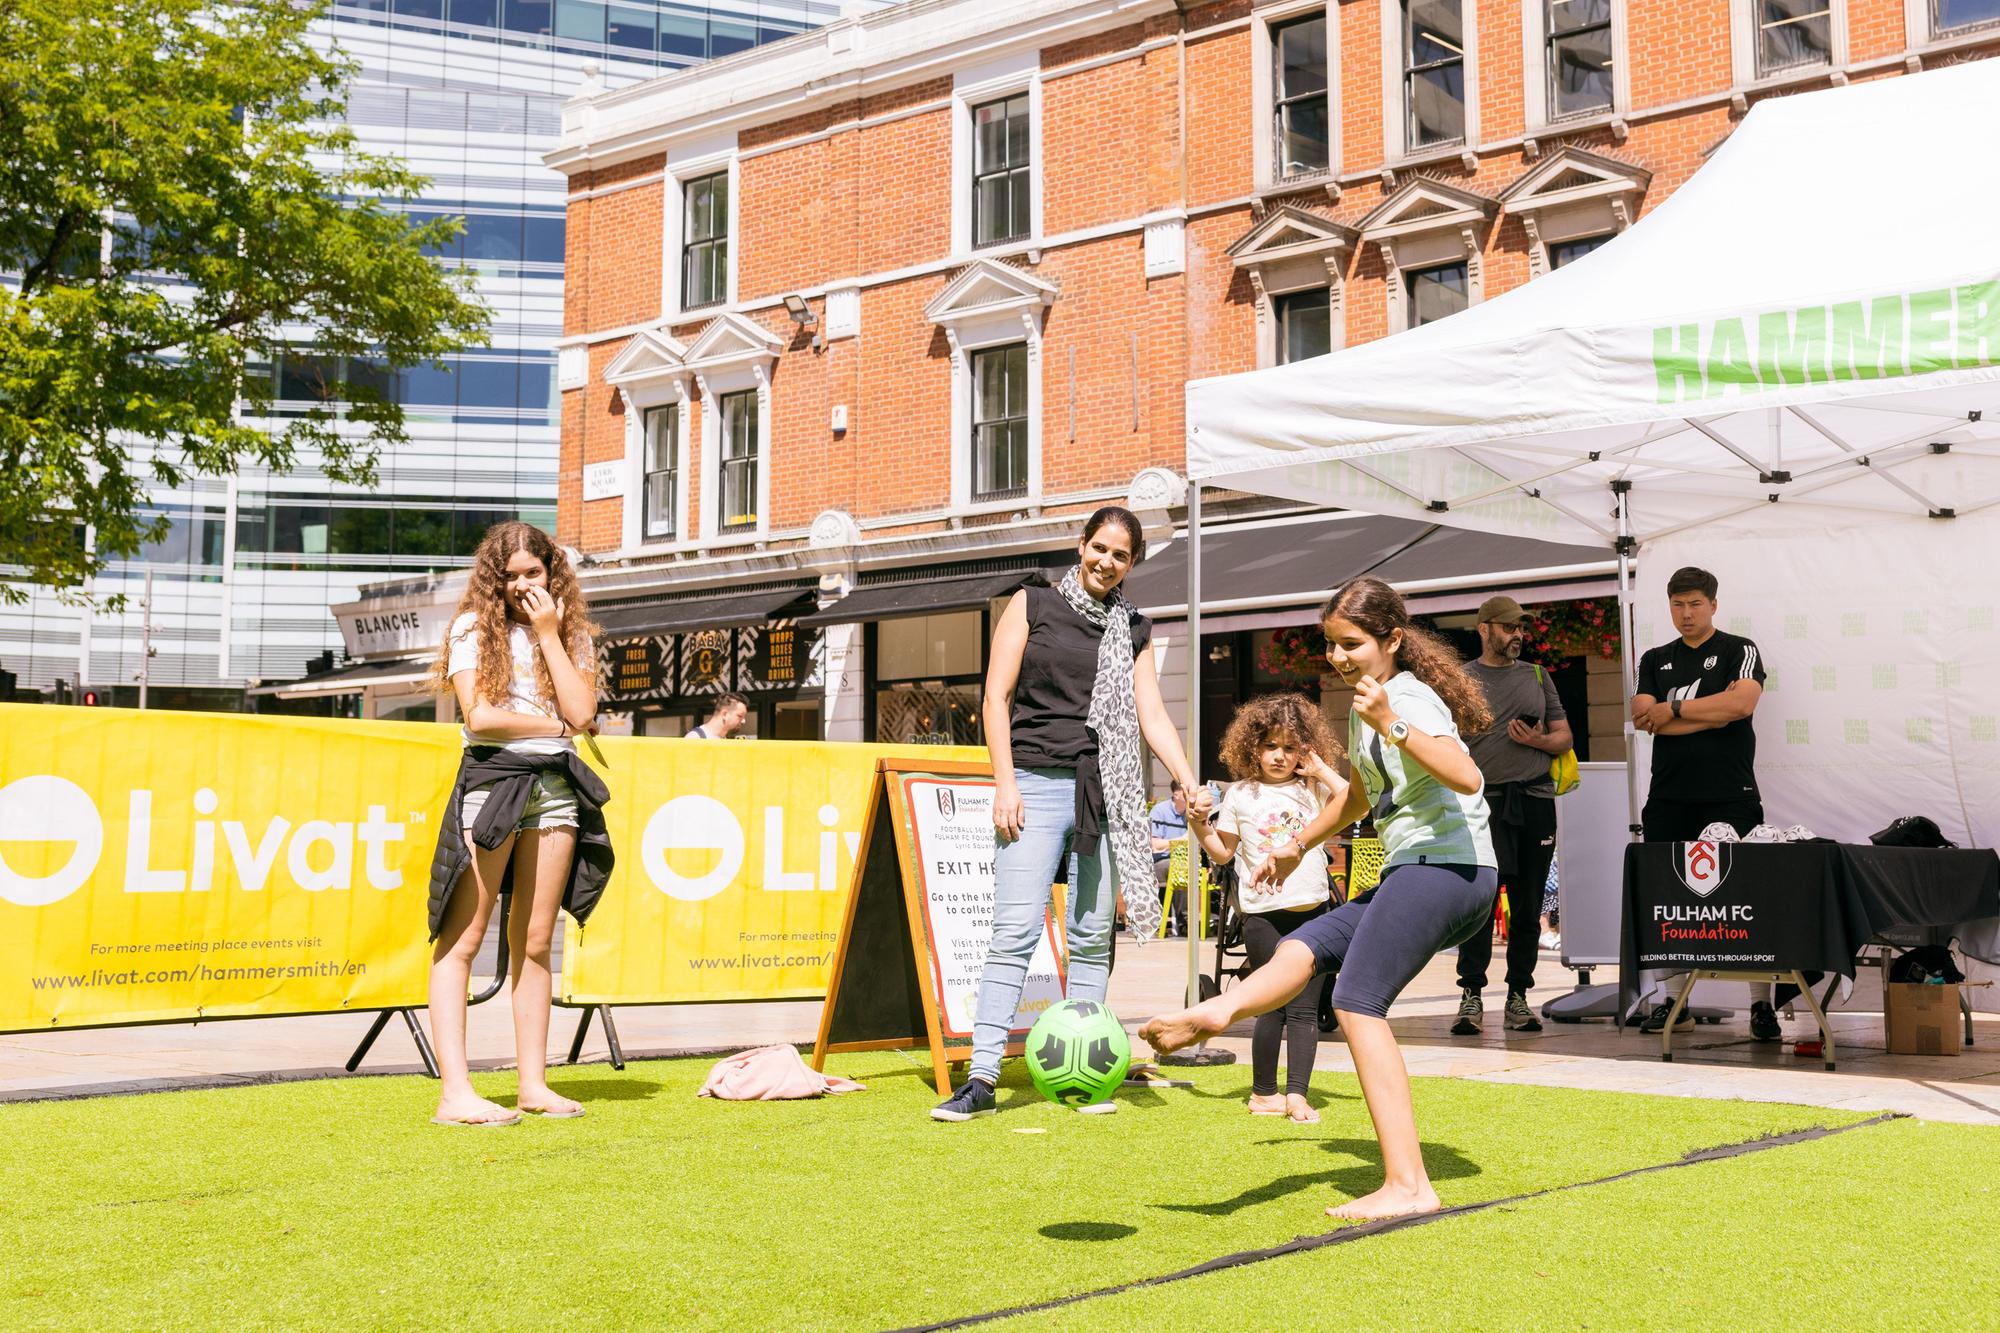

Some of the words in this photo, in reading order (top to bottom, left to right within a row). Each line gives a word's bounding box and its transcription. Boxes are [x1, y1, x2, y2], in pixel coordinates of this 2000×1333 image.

[1652, 279, 2000, 405] HAMMER
[355, 612, 420, 635] BLANCHE
[689, 632, 725, 655] BABA
[769, 631, 794, 644] WRAPS
[625, 649, 647, 661] FRESH
[770, 643, 793, 656] BOXES
[770, 655, 792, 668] MEZZE
[621, 662, 649, 676] HEALTHY
[768, 667, 795, 681] DRINKS
[619, 677, 651, 690] LEBANESE
[957, 797, 982, 805] FULHAM
[982, 798, 990, 806] FC
[940, 826, 973, 834] FOOTBALL
[123, 787, 405, 893] Livat
[934, 833, 960, 841] FULHAM
[937, 861, 972, 875] EXIT
[931, 892, 943, 902] Go
[948, 893, 958, 902] to
[962, 892, 979, 902] the
[983, 892, 995, 902] IK
[946, 905, 957, 914] to
[1653, 905, 1727, 921] FULHAM
[1731, 905, 1754, 921] FC
[739, 931, 757, 942] For
[760, 933, 788, 941] more
[791, 930, 837, 943] meeting
[1661, 921, 1749, 942] Foundation
[90, 942, 114, 955] For
[116, 943, 153, 955] more
[155, 939, 209, 954] meeting
[212, 938, 248, 953] place
[250, 938, 293, 950] events
[296, 936, 322, 949] visit
[951, 939, 972, 948] Visit
[954, 952, 973, 961] tent
[1668, 953, 1695, 961] BETTER
[1696, 954, 1717, 962] LIVES
[1717, 954, 1753, 962] THROUGH
[1753, 954, 1775, 962] SPORT
[31, 960, 367, 990] www.livat.com/hammersmith/en
[964, 965, 983, 973] tent
[947, 977, 972, 986] more
